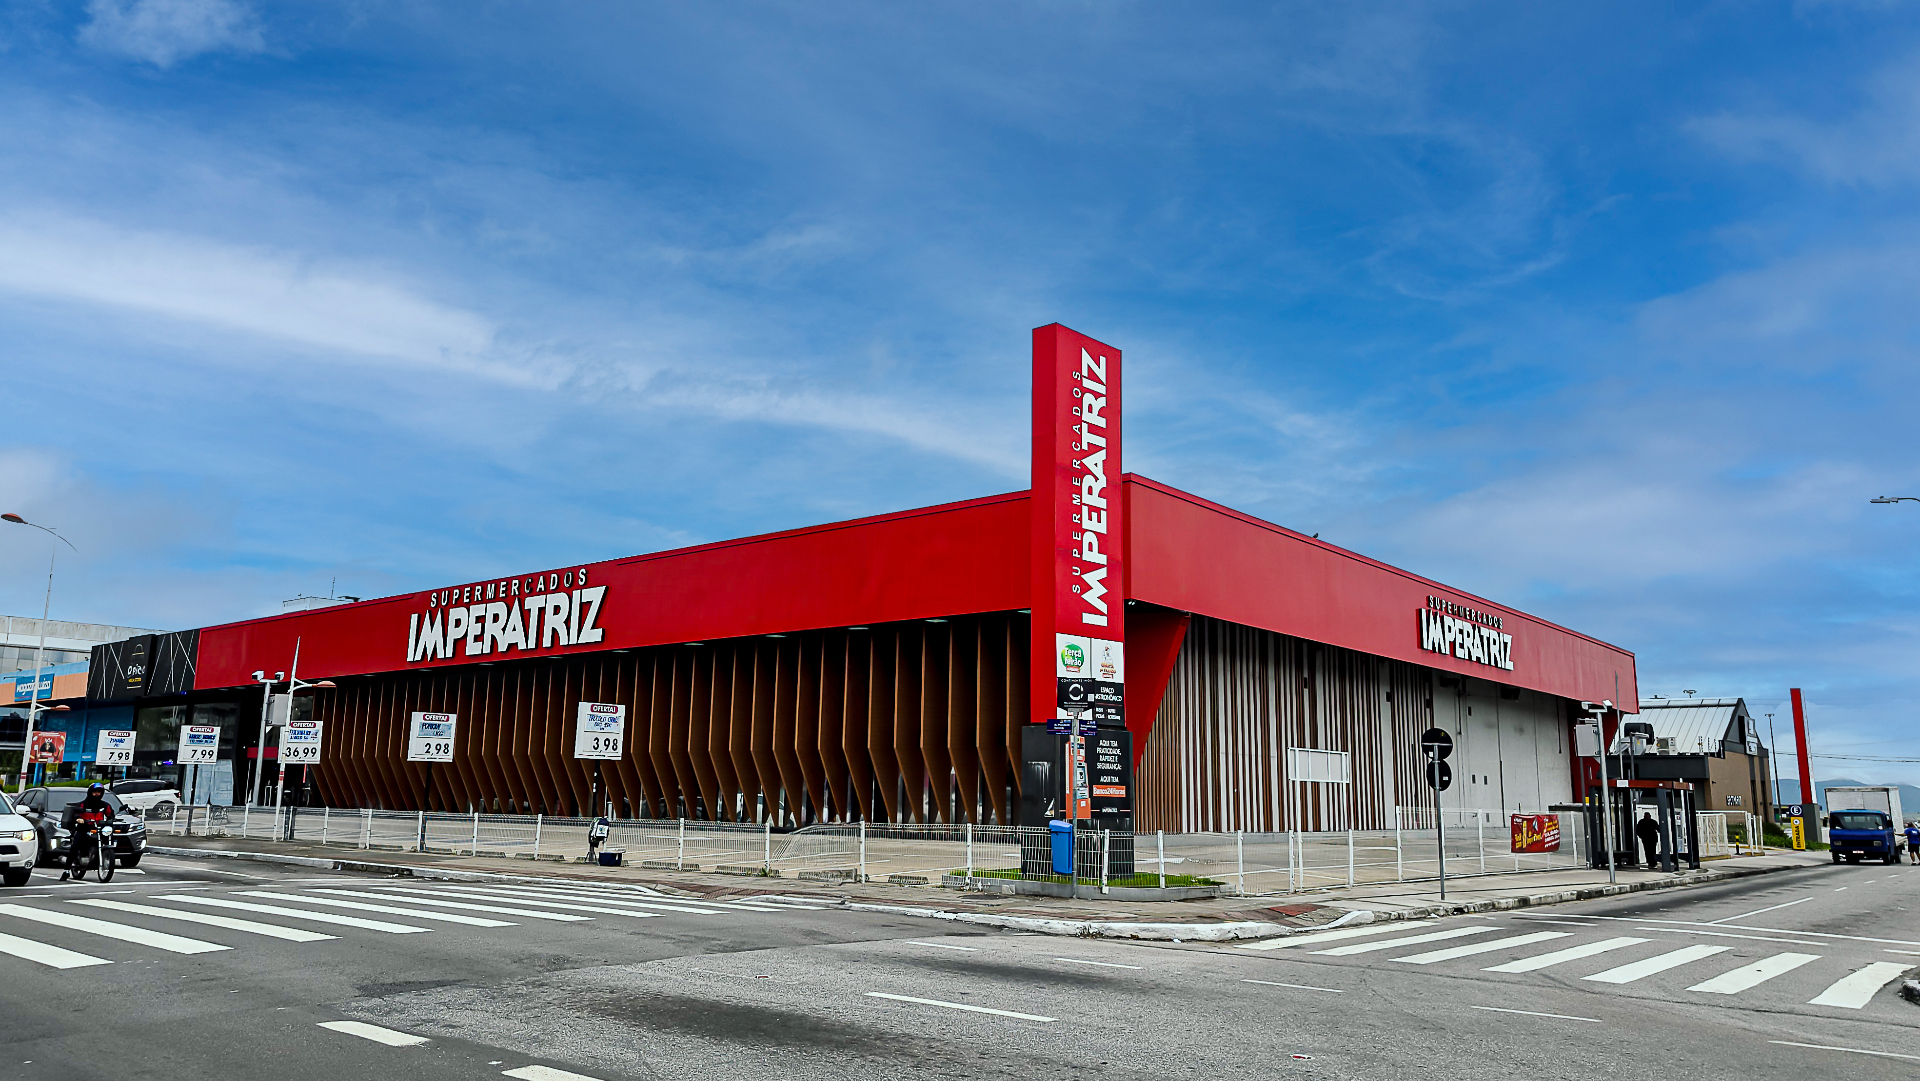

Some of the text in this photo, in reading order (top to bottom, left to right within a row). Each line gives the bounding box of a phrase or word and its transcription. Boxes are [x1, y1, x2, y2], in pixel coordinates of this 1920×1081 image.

[1072, 370, 1081, 594] SUPERMERCADOS
[1081, 347, 1108, 627] IMPERATRIZ
[431, 568, 587, 608] SUPERMERCADOS
[1427, 594, 1503, 629] SUPERMERCADOS
[406, 585, 607, 662] IMPERATRIZ
[1420, 608, 1514, 671] IMPERATRIZ
[1065, 648, 1081, 658] Terça
[1065, 657, 1082, 667] feirão
[592, 705, 616, 713] OFERTA!
[424, 742, 450, 756] 2,98
[592, 737, 618, 753] 3,98
[108, 751, 130, 762] 7,98
[191, 749, 215, 760] 7,99
[285, 746, 318, 759] 36,99
[1093, 786, 1125, 795] Banco24Horas
